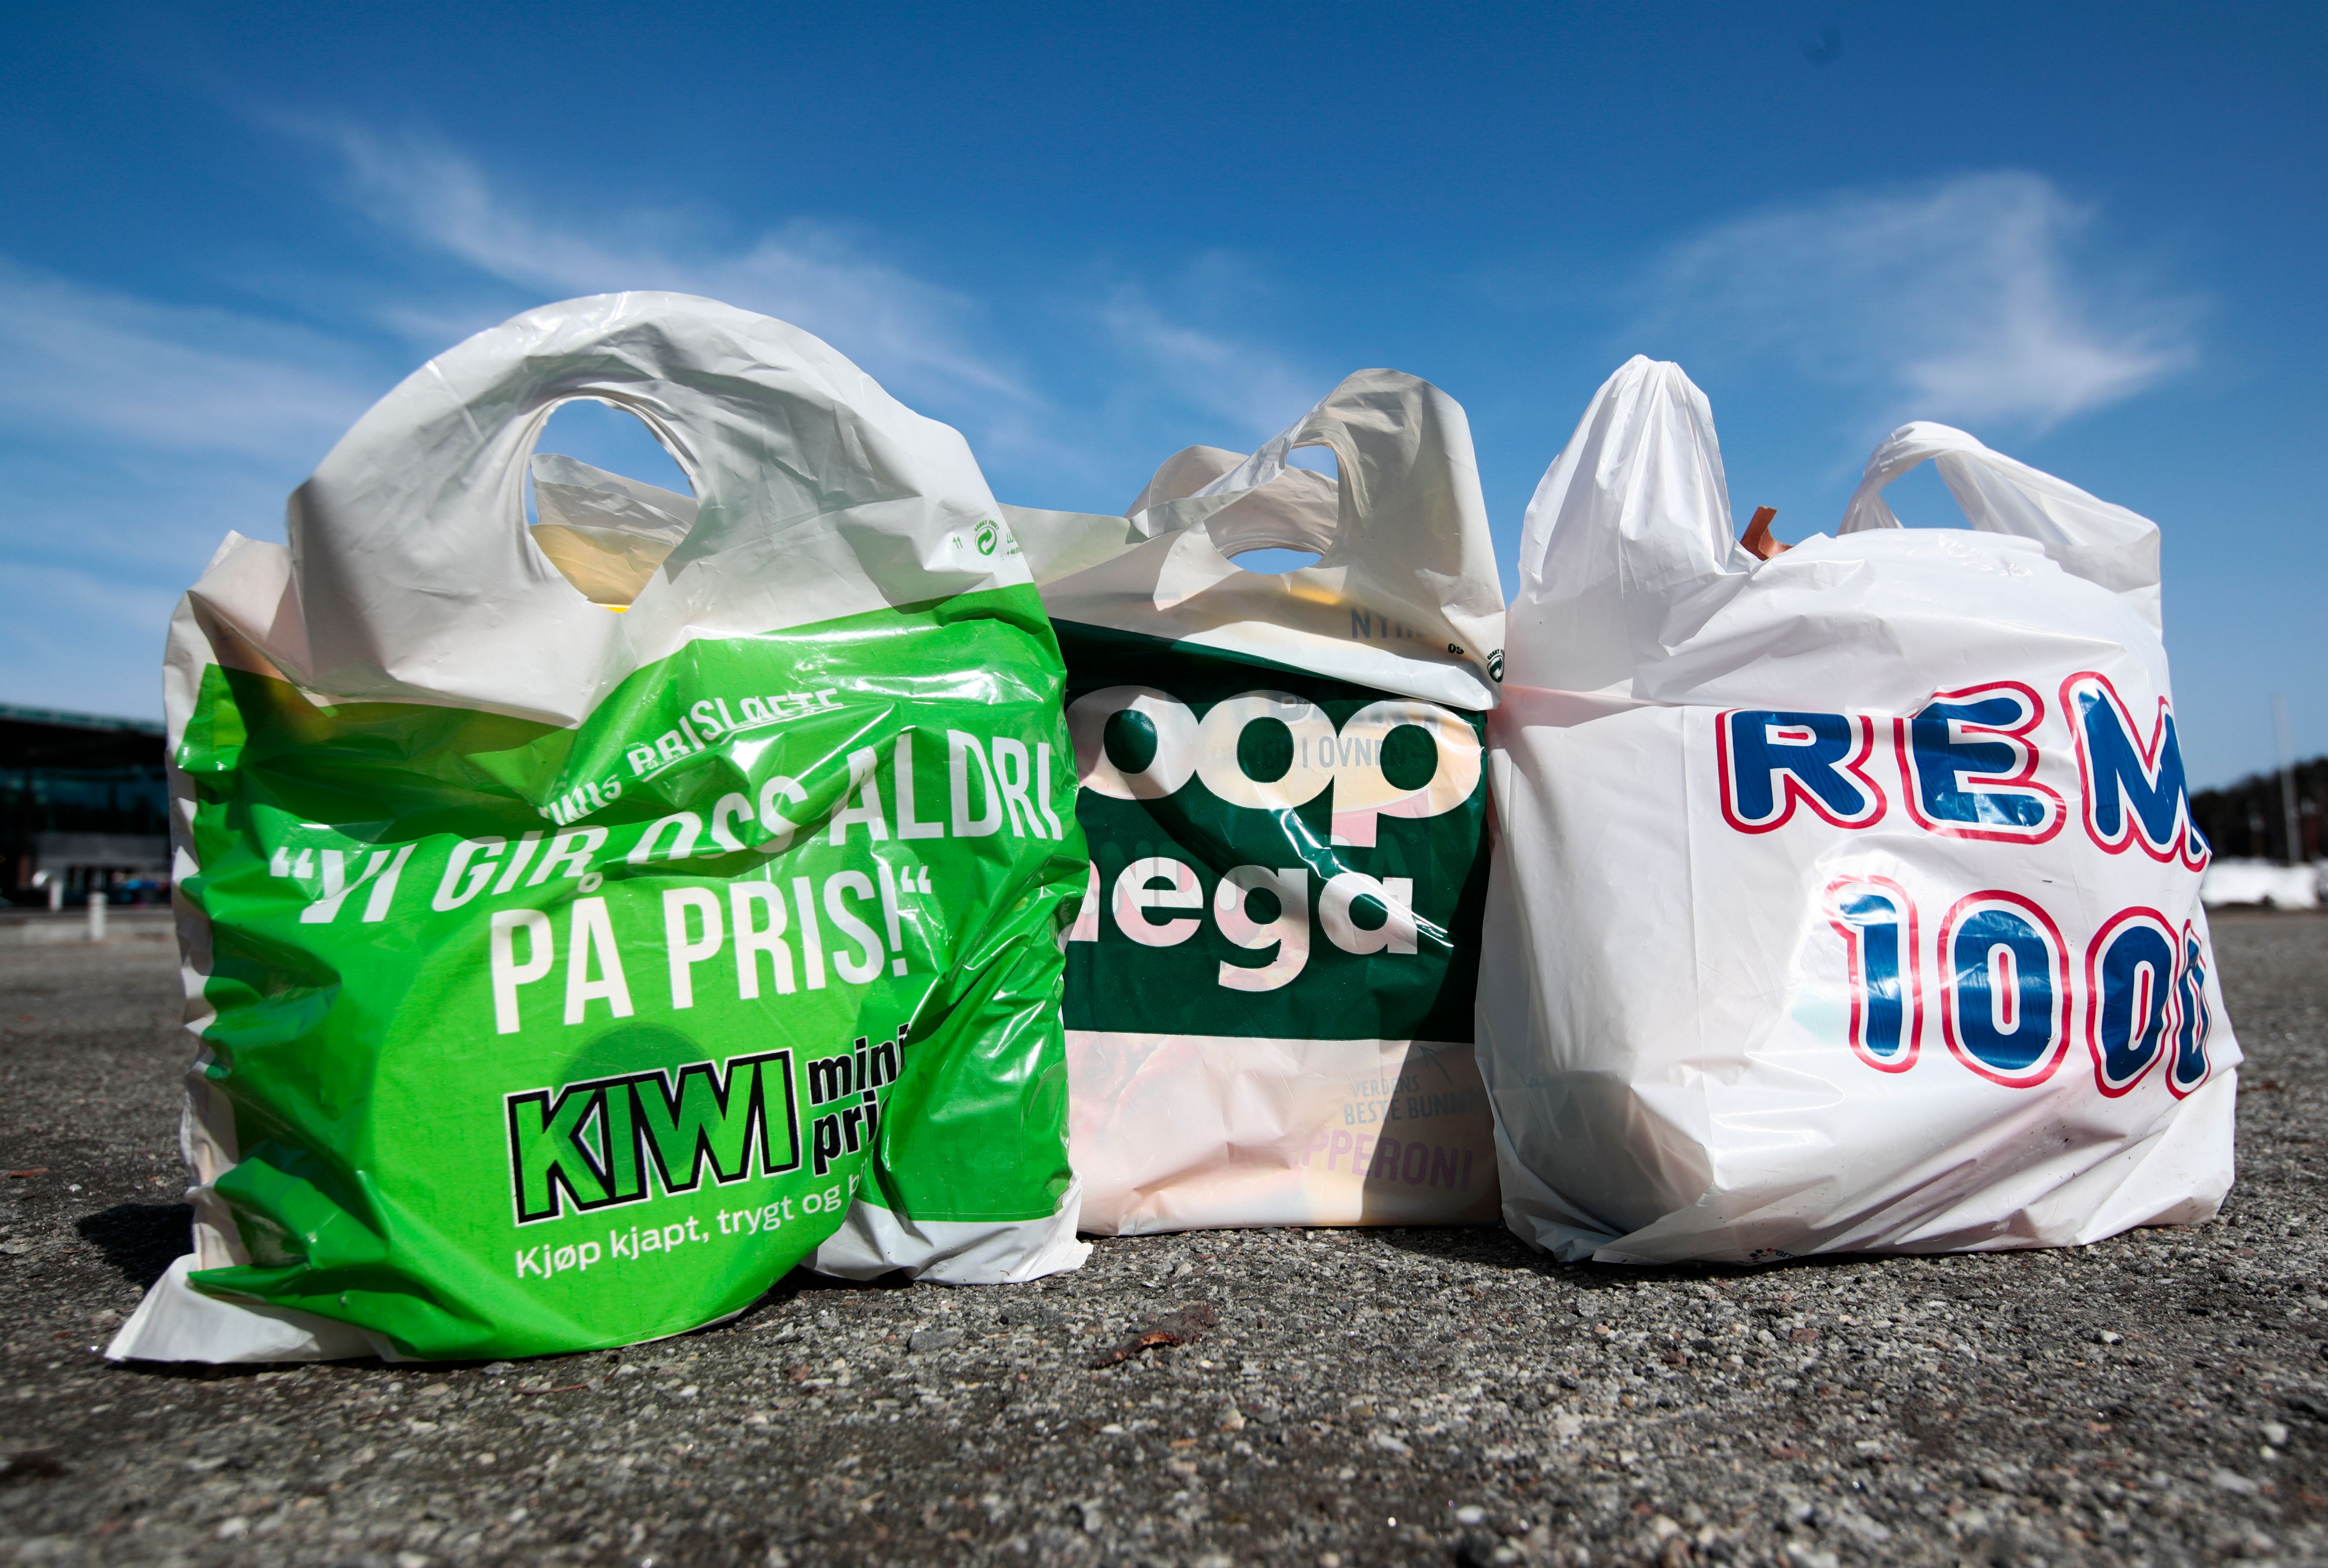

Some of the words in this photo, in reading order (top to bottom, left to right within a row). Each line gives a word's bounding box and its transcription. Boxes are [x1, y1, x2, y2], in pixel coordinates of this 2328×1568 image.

[952, 536, 963, 549] 11
[1448, 643, 1464, 655] 09
[432, 825, 609, 912] GIR
[829, 729, 1063, 846] ALDRI
[1066, 685, 1483, 848] oop
[1716, 671, 2212, 873] REM
[490, 871, 634, 1034] PÅ
[1067, 856, 1418, 992] ega
[1823, 875, 2211, 1101] 1000
[503, 1047, 802, 1227] KIWI
[813, 1089, 882, 1177] pri
[1300, 1128, 1474, 1192] PPERONI
[1343, 1097, 1402, 1126] BESTE
[515, 1237, 602, 1279] Kjøp
[610, 1215, 709, 1261] kjapt,
[717, 1195, 794, 1236] trygt
[802, 1184, 842, 1214] og
